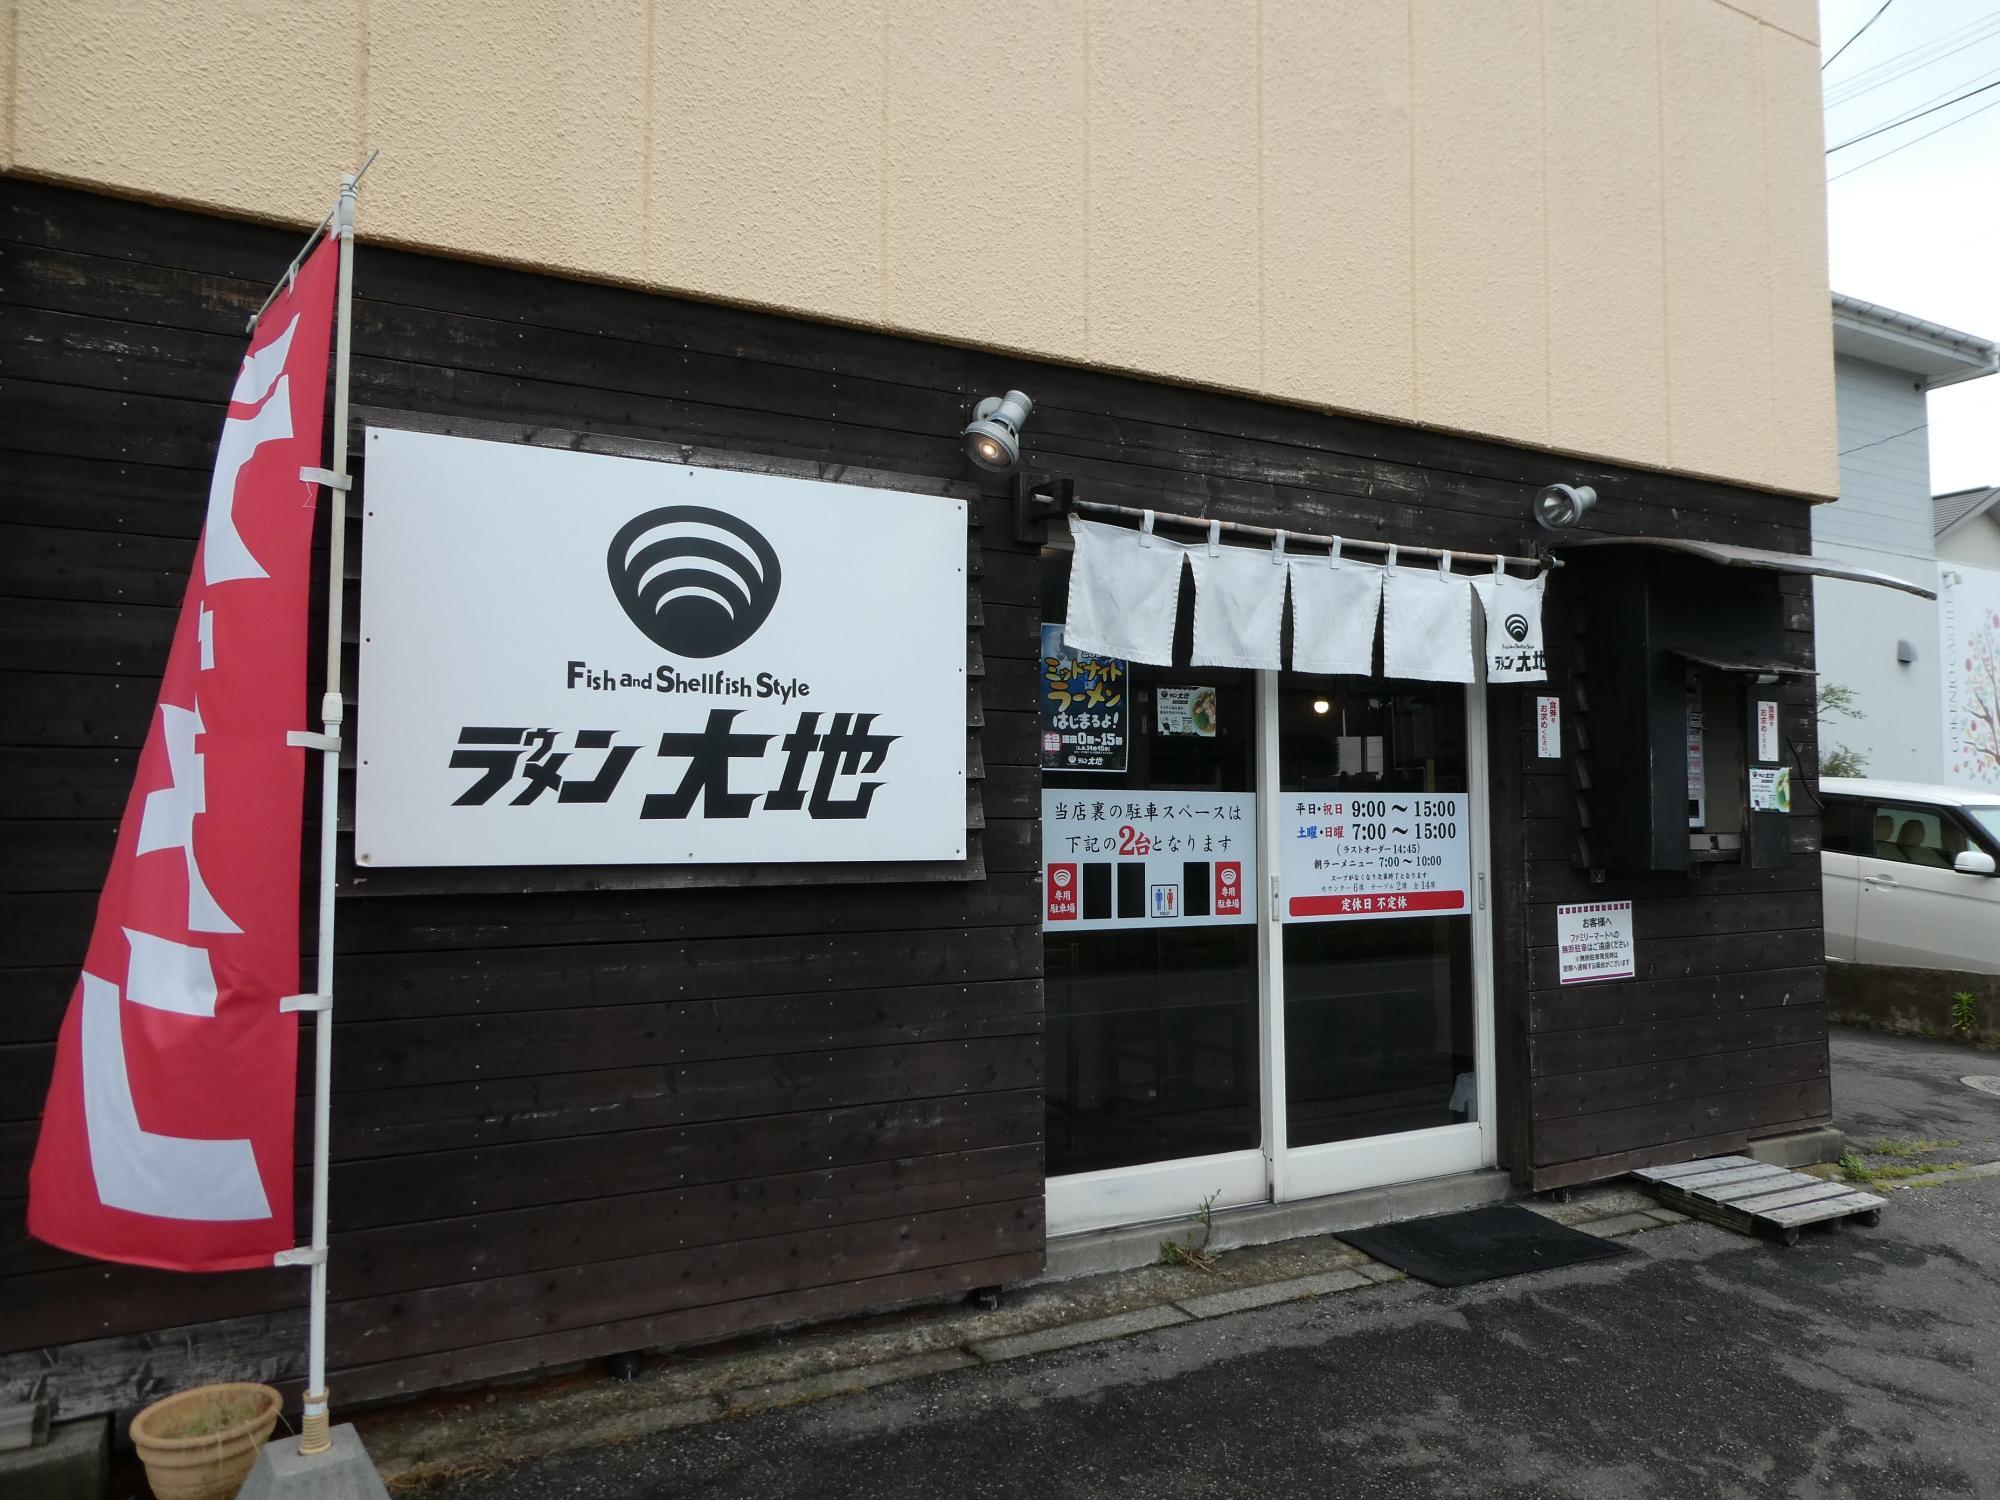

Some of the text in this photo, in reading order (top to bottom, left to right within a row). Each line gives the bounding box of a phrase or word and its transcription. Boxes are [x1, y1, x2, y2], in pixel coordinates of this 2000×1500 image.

[1044, 657, 1123, 682] ミッドナイト
[567, 660, 810, 705] Fish and Shellfish Style
[1047, 681, 1121, 712] ラーメン
[639, 708, 905, 819] 大地
[1055, 801, 1242, 822] 当店裏の駐車スペースは
[1352, 800, 1385, 817] 9:00
[1414, 800, 1455, 817] 15:00
[1352, 823, 1386, 840] 7:00
[1415, 823, 1456, 839] 15:00
[1065, 825, 1232, 856] 下記の2台となります
[1416, 856, 1441, 866] 10:00
[1054, 890, 1071, 900] 専用
[1221, 886, 1236, 897] 専用
[1050, 903, 1076, 914] 駐車場
[1217, 899, 1239, 909] 駐車場
[1341, 896, 1408, 911] 定休日 不定休
[1582, 916, 1613, 929] お客様へ
